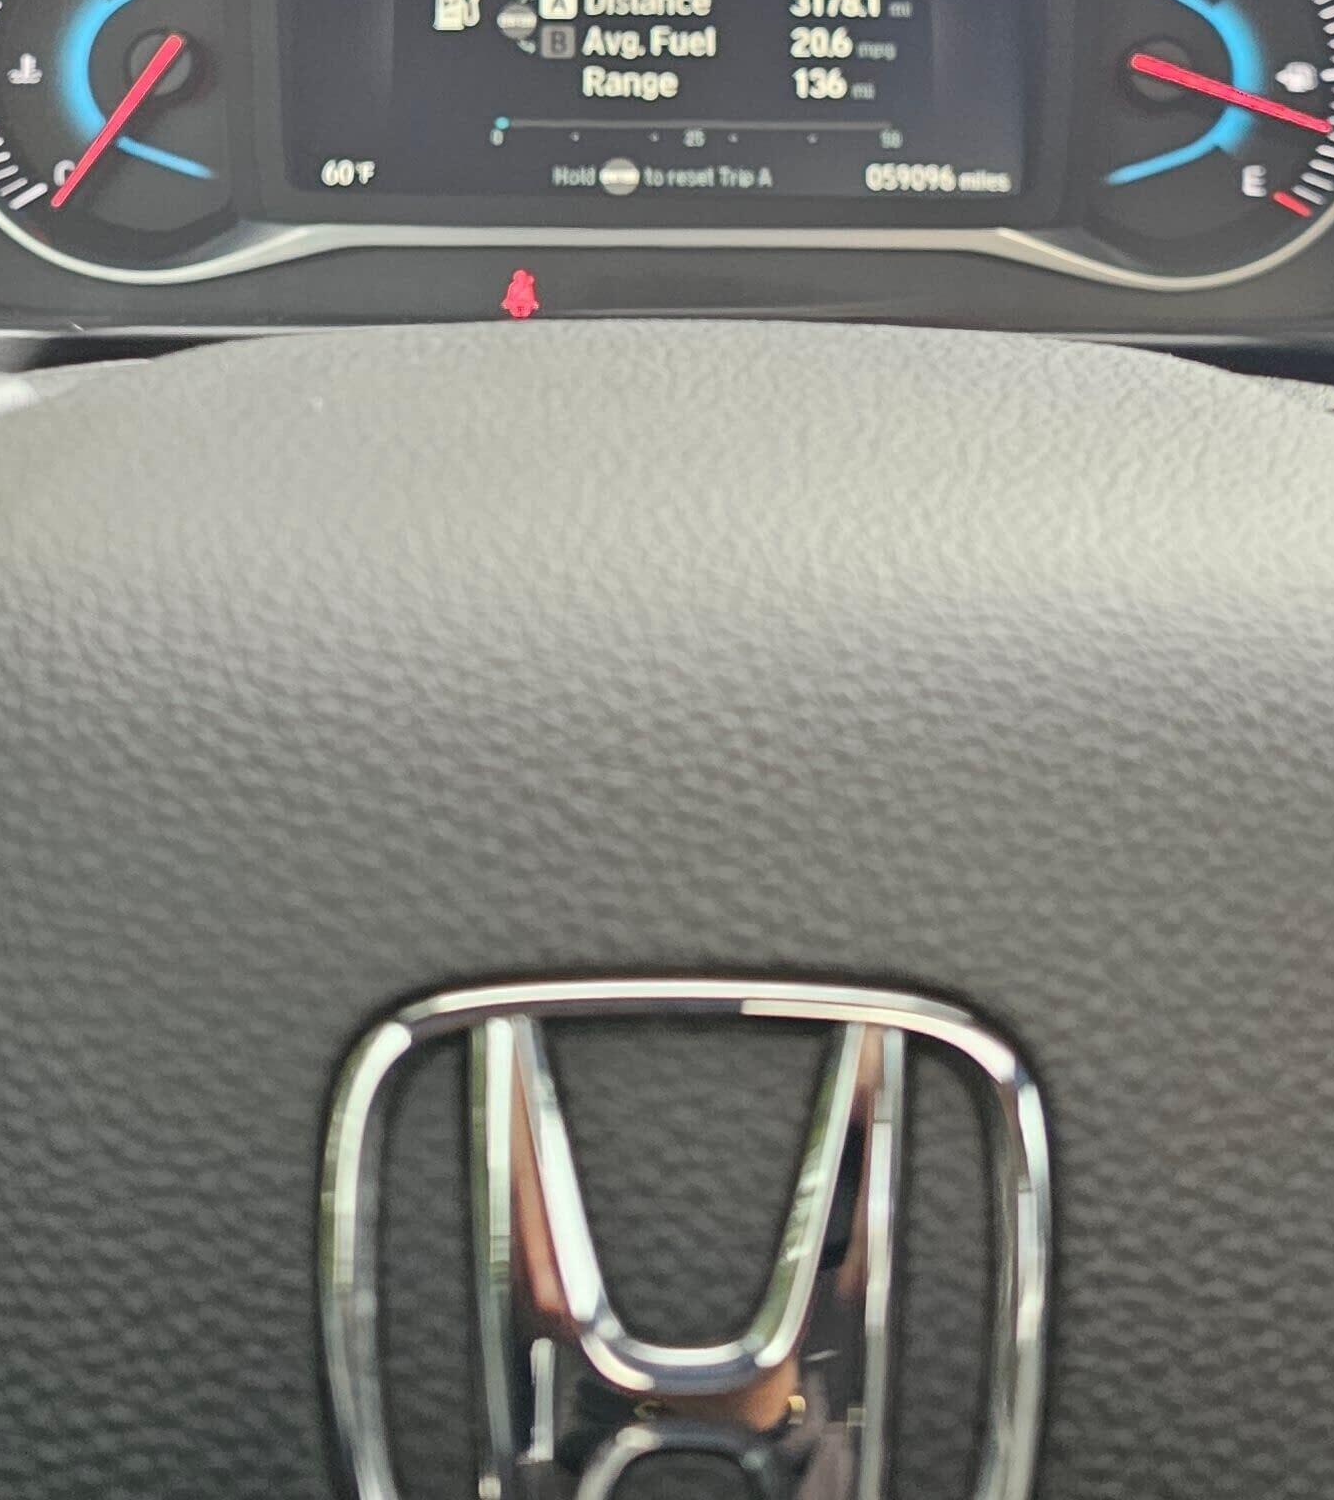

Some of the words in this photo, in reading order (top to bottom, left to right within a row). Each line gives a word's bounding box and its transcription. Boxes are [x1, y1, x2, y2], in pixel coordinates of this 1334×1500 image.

[582, 25, 646, 60] Avg.
[649, 24, 717, 57] Fuel
[790, 26, 854, 58] 20.6
[582, 65, 679, 101] Range
[791, 67, 848, 100] 136
[552, 165, 597, 187] Hold
[643, 166, 664, 187] to
[667, 166, 715, 187] reset
[719, 165, 754, 188] Trip
[758, 166, 773, 187] A
[866, 163, 956, 192] 059096
[958, 169, 1012, 192] miles
[1242, 165, 1266, 197] E
